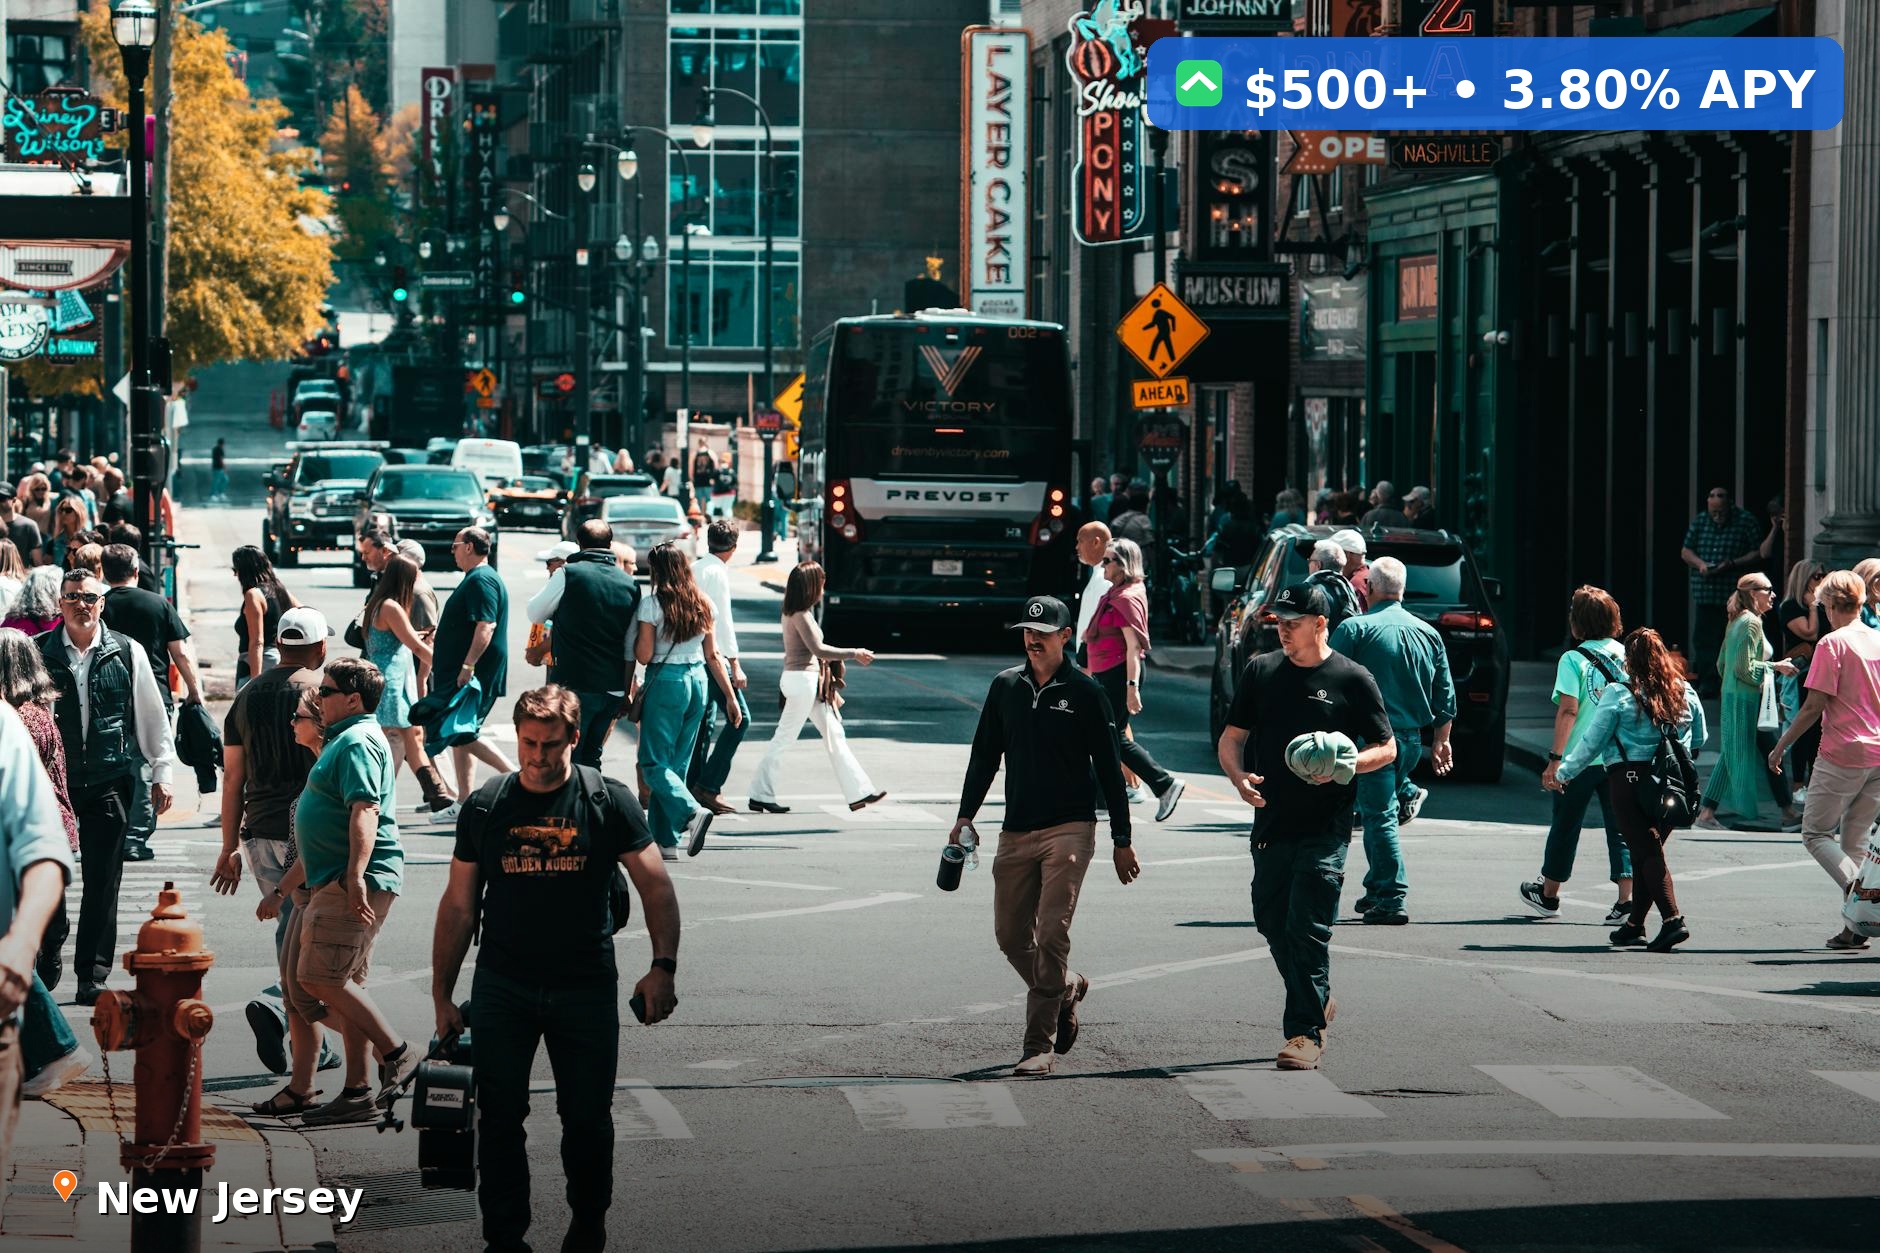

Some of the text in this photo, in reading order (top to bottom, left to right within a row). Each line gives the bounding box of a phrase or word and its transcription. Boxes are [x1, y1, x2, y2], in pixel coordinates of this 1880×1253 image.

[1319, 136, 1386, 159] OPE
[1403, 142, 1491, 164] NASHVILLE
[478, 132, 493, 211] HYATT
[984, 44, 1013, 285] LAYER CAKE
[1092, 111, 1114, 233] PONY
[20, 263, 47, 272] SINCE
[1184, 276, 1282, 306] MUSEUM
[1008, 326, 1037, 339] 002
[1139, 385, 1184, 402] AHEAD
[904, 401, 996, 413] VICTORY
[886, 489, 1010, 503] PREVOST
[501, 855, 588, 874] GOLDEN NUGGET
